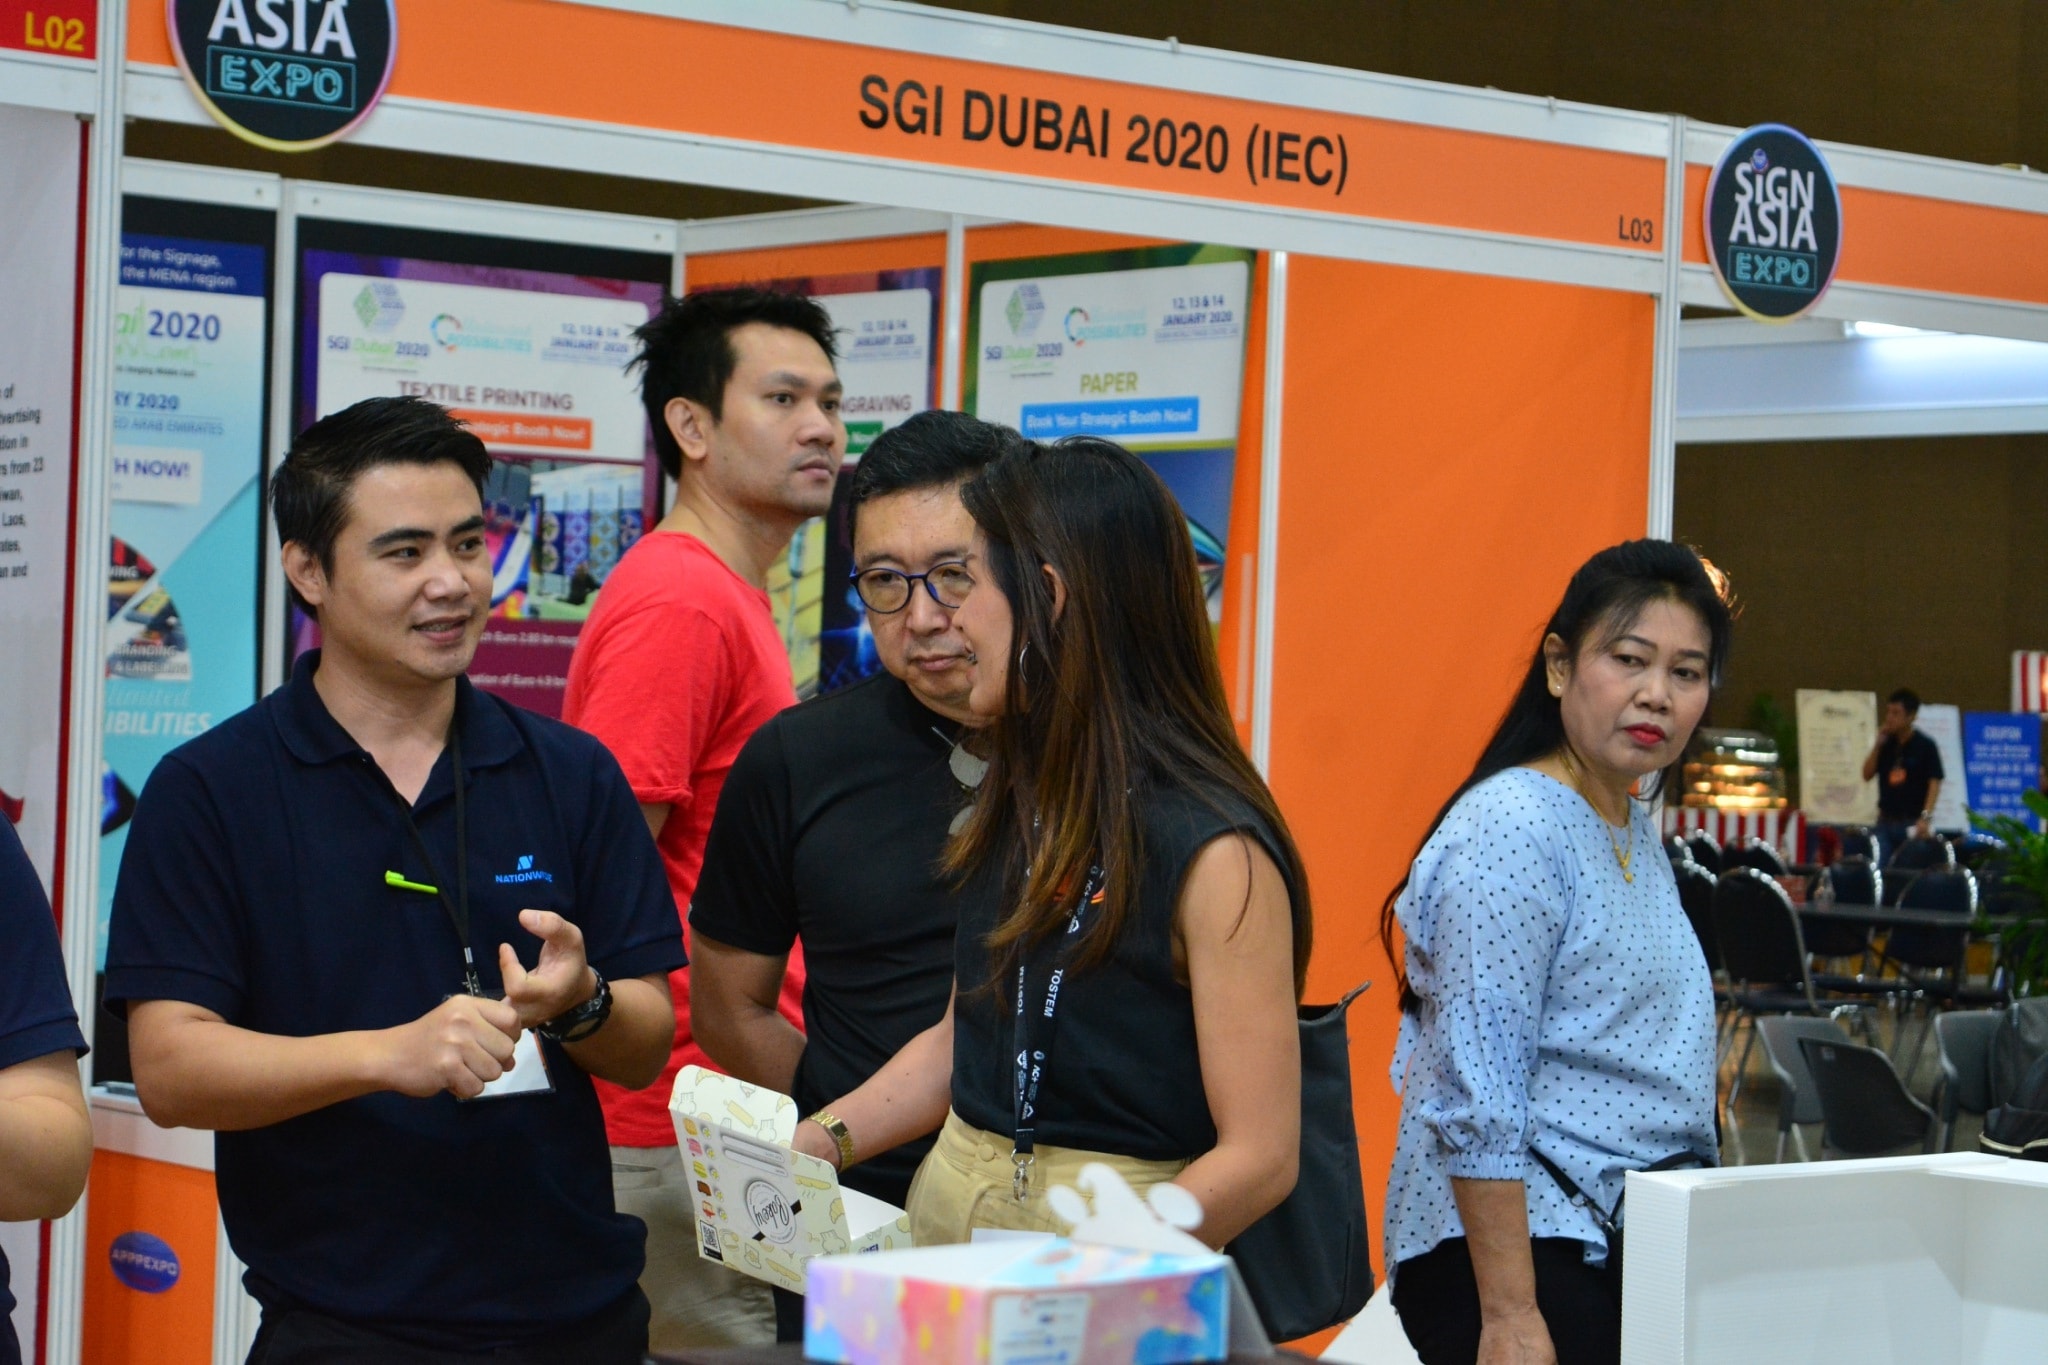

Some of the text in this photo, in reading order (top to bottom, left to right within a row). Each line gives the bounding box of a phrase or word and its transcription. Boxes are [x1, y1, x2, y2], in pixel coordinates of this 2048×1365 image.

[24, 11, 85, 51] L02
[207, 0, 356, 58] ASIA
[219, 54, 344, 103] EXPO
[858, 74, 1349, 196] SGI DUBAI 2020 (IEC)
[1733, 162, 1815, 212] SIGN
[1618, 214, 1654, 244] L03
[1728, 198, 1819, 251] ASIA
[149, 268, 191, 284] MENA
[1734, 252, 1810, 286] EXPO
[1173, 294, 1225, 310] 12, 13 & 14
[148, 309, 222, 342] 2020
[1162, 310, 1234, 327] JANUARY 2020
[395, 340, 432, 358] 2020
[1036, 342, 1064, 359] 2020
[398, 379, 575, 412] TEXTILE PRINTING
[1080, 371, 1138, 395] PAPER
[0, 407, 41, 425] vertising
[137, 393, 180, 411] 2020
[1080, 410, 1128, 430] Strategic
[1130, 408, 1162, 425] Booth
[1164, 406, 1193, 423] Now!
[10, 459, 31, 476] from
[33, 455, 44, 473] 23
[134, 459, 191, 478] NOW!
[1017, 965, 1025, 1016] TOSTEM
[1043, 968, 1065, 1019] TOSTEM
[752, 1193, 790, 1230] Bakery
